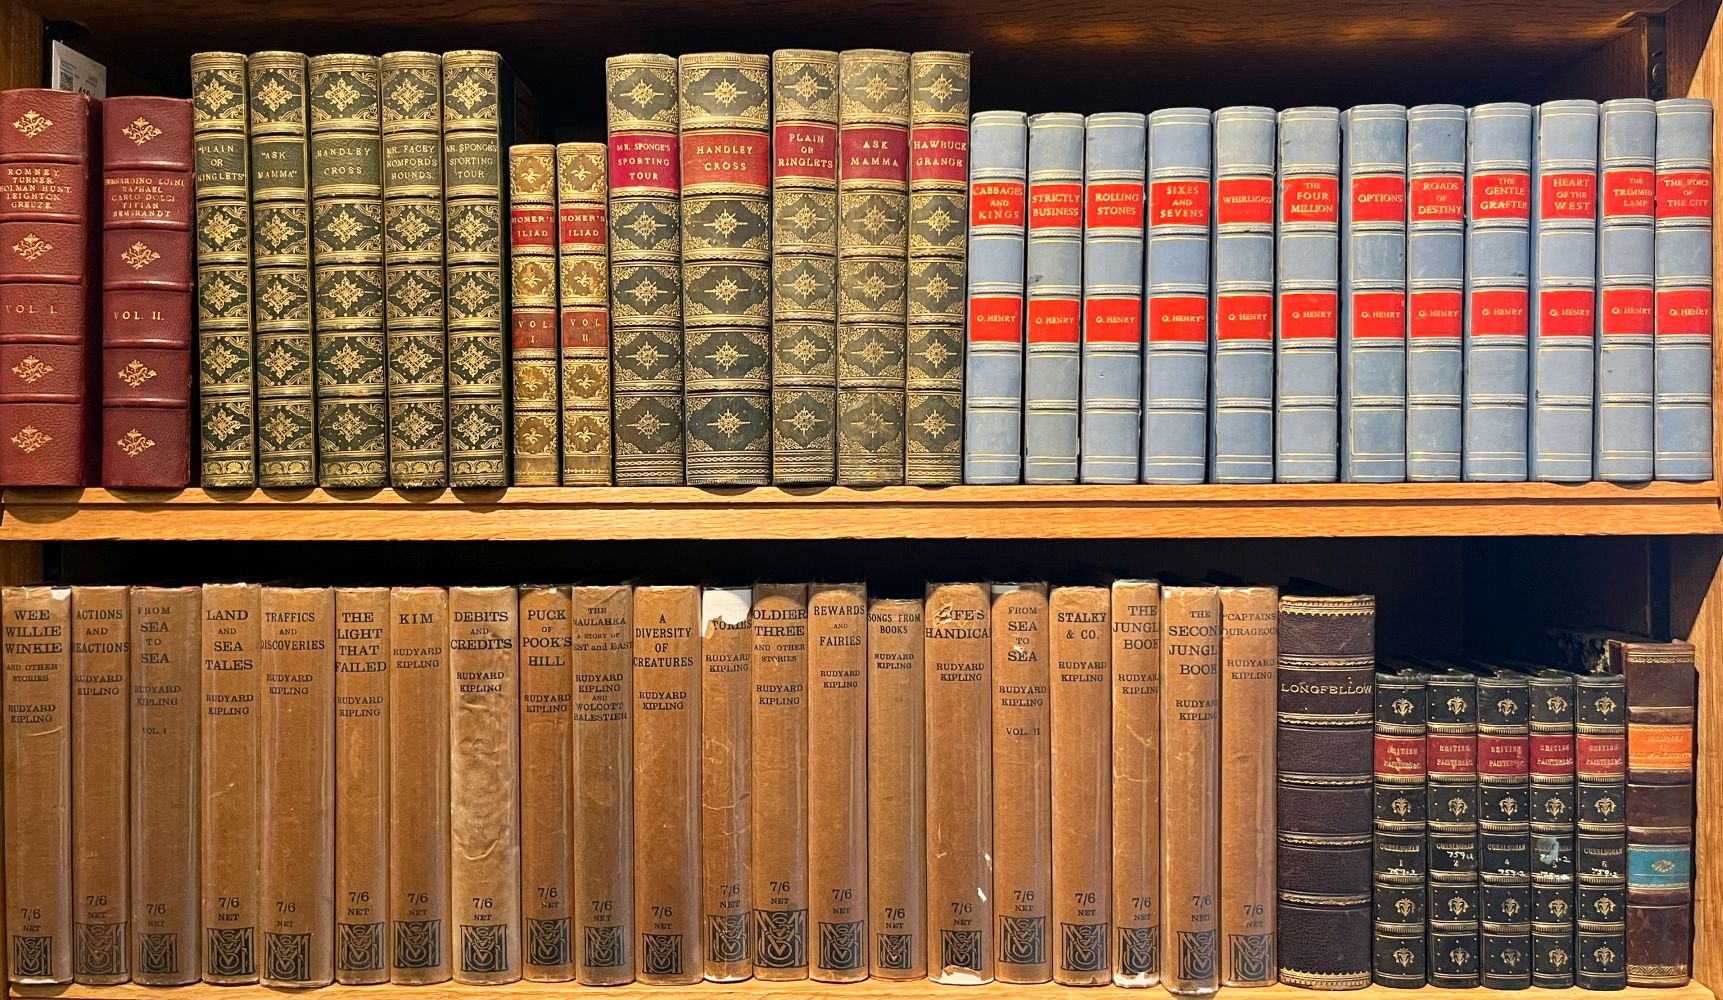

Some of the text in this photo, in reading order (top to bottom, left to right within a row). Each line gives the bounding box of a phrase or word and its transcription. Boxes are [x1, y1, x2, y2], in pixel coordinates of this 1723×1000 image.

[788, 133, 825, 144] PLAIN
[404, 144, 435, 153] FACEY
[616, 143, 671, 152] MR. SPONGE'S
[801, 146, 815, 154] OR
[862, 140, 890, 150] ASK
[913, 140, 967, 151] HAWBUCK
[315, 147, 371, 159] HANDLEY
[696, 145, 754, 156] HANDLEY
[210, 158, 224, 167] OR
[449, 157, 493, 166] SPORTING
[617, 157, 670, 167] SPORTING
[704, 161, 747, 172] CROSS
[777, 158, 834, 169] RINGLETS
[850, 156, 899, 168] MAMMA
[916, 157, 963, 168] GRANGE
[324, 166, 362, 175] CROSS
[629, 172, 659, 181] TOUR
[1498, 177, 1515, 185] THE
[1423, 182, 1459, 191] ROADS
[1553, 178, 1591, 188] HEART
[1664, 179, 1684, 187] THE
[972, 186, 1024, 196] CABBAGES
[1166, 185, 1200, 195] SIXES
[1484, 186, 1525, 196] GENTLE
[1613, 188, 1653, 197] TRIMMED
[1031, 194, 1080, 204] STRICTLY
[1095, 192, 1139, 202] ROLLING
[1222, 195, 1272, 205] WHIRLIGIGS
[1296, 191, 1329, 200] FOUR
[1357, 194, 1403, 203] OPTIONS
[1479, 200, 1528, 210] GRAFTER
[1554, 201, 1590, 211] WEST
[1667, 199, 1708, 207] THE CITY
[1032, 206, 1079, 217] BUSINESS
[1096, 205, 1136, 216] STONES
[1159, 209, 1204, 219] SEVENS
[1290, 204, 1334, 214] MILLION
[1417, 206, 1462, 215] DESTINY
[561, 214, 605, 224] HOMER'S
[978, 210, 1019, 220] KINGS
[517, 229, 549, 238] ILIAD
[567, 229, 600, 237] ILIAD
[1372, 310, 1400, 319] HENRY
[1680, 307, 1709, 316] HENRY
[987, 314, 1016, 323] HENRY
[1106, 315, 1135, 324] HENRY
[14, 610, 50, 620] WEE
[76, 609, 123, 619] ACTIONS
[137, 607, 170, 615] FROM
[206, 610, 249, 620] LAND
[527, 610, 566, 620] PUCK
[813, 605, 865, 616] REWARDS
[265, 612, 315, 622] TRAFFICS
[341, 612, 374, 623] THE
[399, 613, 433, 624] KIM
[454, 611, 508, 622] DEBITS
[658, 614, 666, 624] A
[867, 612, 921, 622] SONGS FROM
[1057, 612, 1107, 623] STALKY
[5, 626, 62, 637] WILLIE
[140, 622, 169, 633] SEA
[754, 626, 804, 637] THREE
[880, 625, 908, 634] BOOKS
[1008, 621, 1037, 632] SEA
[337, 628, 382, 639] LIGHT
[635, 628, 692, 638] DIVERSITY
[1066, 630, 1099, 640] & CO.
[214, 641, 244, 651] SEA
[451, 639, 512, 649] CREDITS
[522, 637, 572, 648] POOK'S
[819, 636, 861, 647] FAIRIES
[1016, 637, 1030, 645] TO
[5, 643, 62, 654] WINKIE
[339, 645, 379, 655] THAT
[393, 647, 442, 655] RUDYARD
[655, 643, 669, 653] OF
[141, 653, 169, 664] SEA
[527, 656, 565, 666] HILL
[1007, 651, 1038, 662] SEA
[205, 659, 253, 670] TALES
[335, 662, 387, 672] FAILED
[396, 660, 439, 668] KIPLING
[633, 657, 694, 667] CREATURES
[1058, 661, 1107, 669] RUDYARD
[1061, 674, 1103, 682] KIPLING
[999, 685, 1046, 694] RUDYARD
[1281, 684, 1372, 694] LONGFELLOW
[206, 694, 254, 702] RUDYARD
[8, 704, 56, 712] RUDYARD
[208, 707, 249, 715] KIPLING
[576, 703, 623, 711] WOLCOTT
[10, 715, 53, 724] KIPLING
[1006, 728, 1028, 736] VOL.
[769, 881, 790, 893] 7/6
[349, 891, 370, 903] 7/6
[1074, 893, 1096, 904] 7/6
[218, 897, 240, 908] 7/6
[472, 898, 493, 909] 7/6
[652, 906, 672, 917] 7/6
[951, 902, 972, 914] 7/6
[1077, 909, 1096, 917] NET
[218, 913, 240, 921] NET
